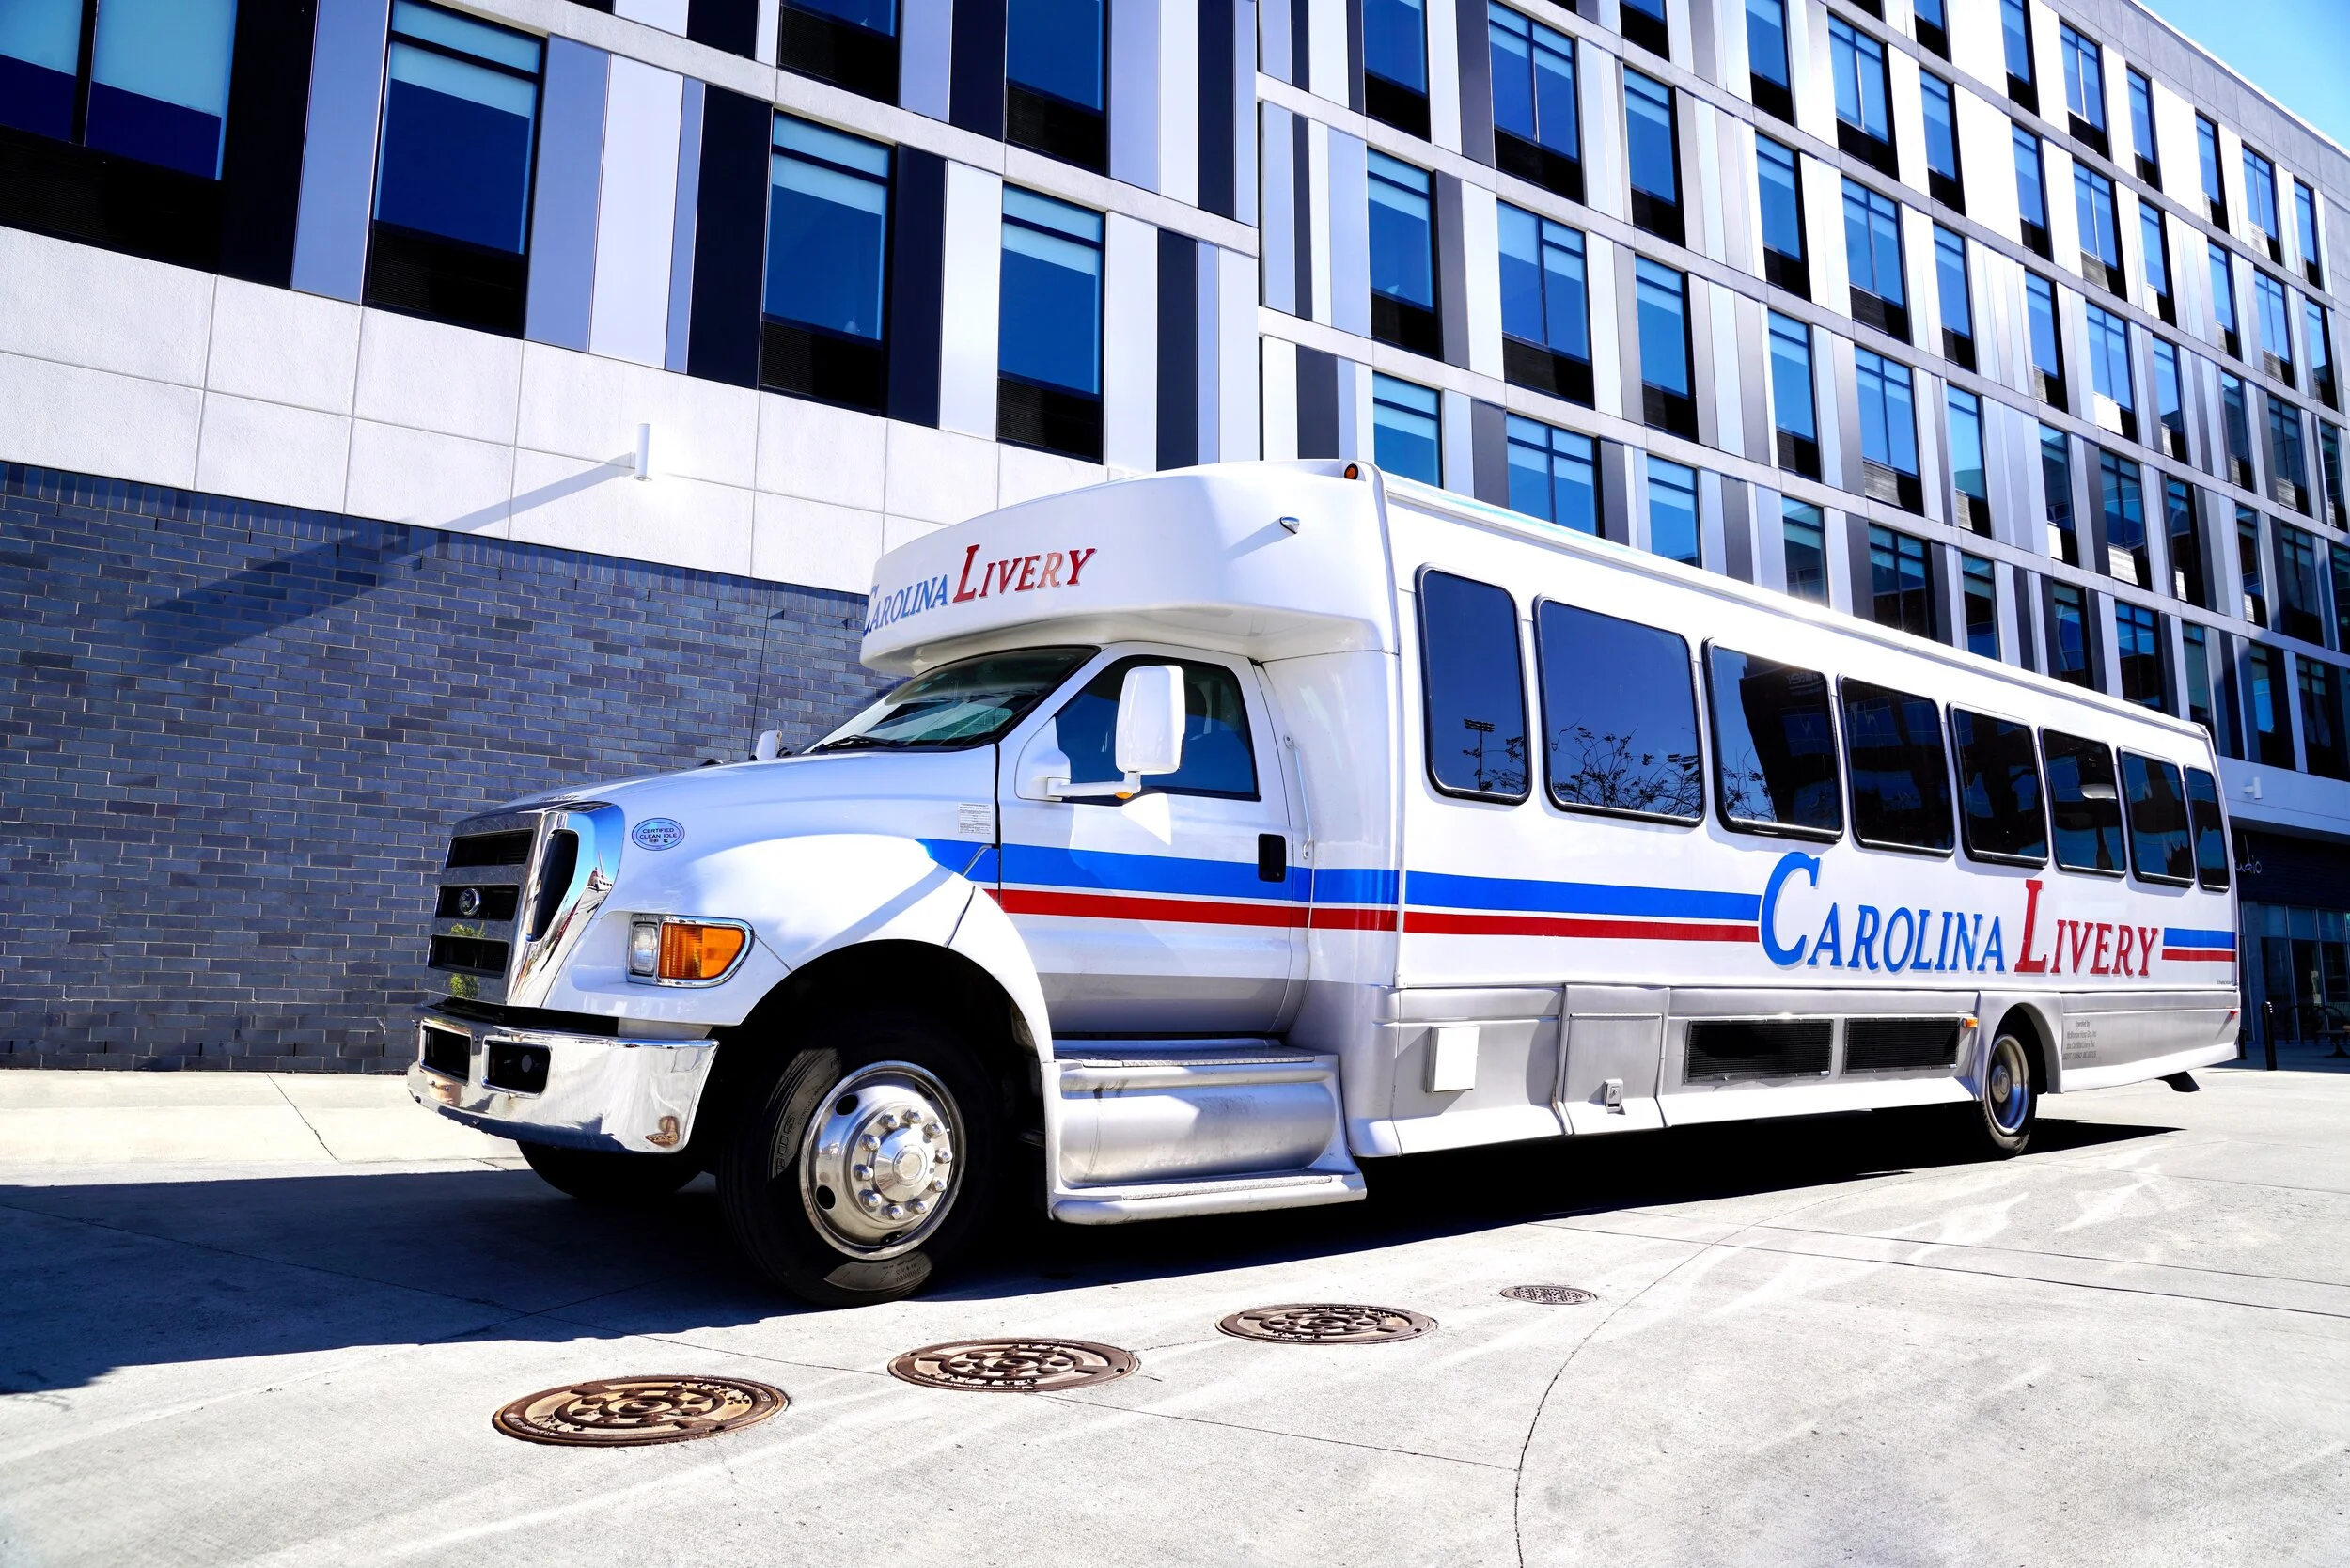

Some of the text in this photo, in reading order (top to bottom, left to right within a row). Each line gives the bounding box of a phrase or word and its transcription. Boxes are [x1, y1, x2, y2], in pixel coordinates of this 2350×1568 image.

[952, 543, 1097, 604] LIVERY
[1761, 851, 2159, 978] CAROLINA LIVERY
